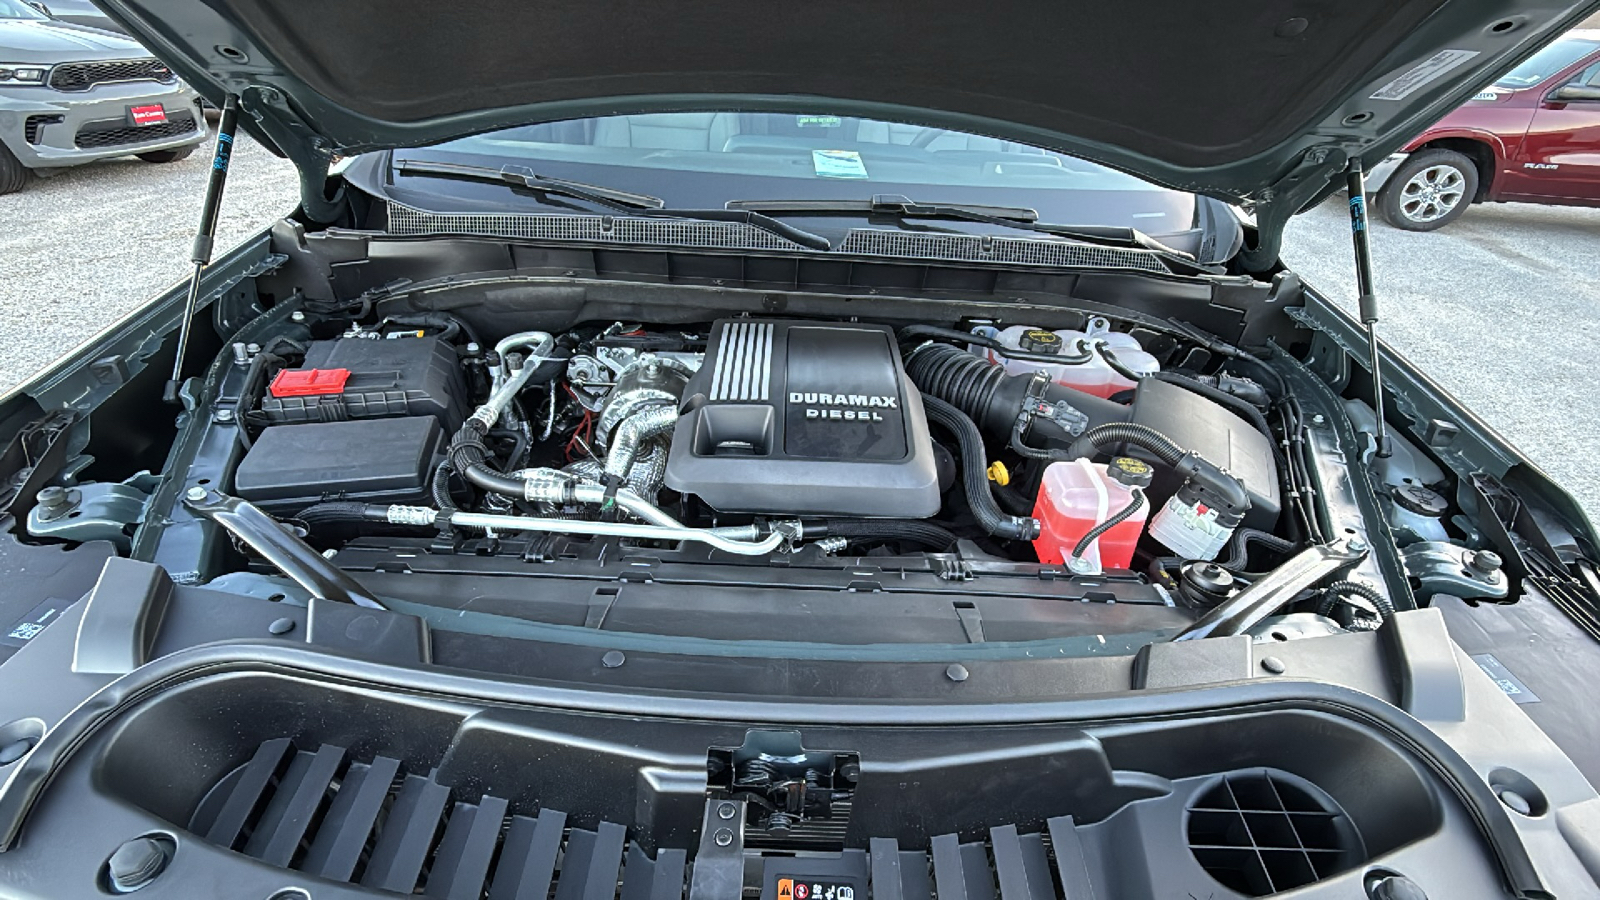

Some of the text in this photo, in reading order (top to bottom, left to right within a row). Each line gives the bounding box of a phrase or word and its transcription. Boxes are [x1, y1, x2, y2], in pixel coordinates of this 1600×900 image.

[1523, 162, 1559, 170] RAM
[789, 392, 897, 408] DURAMAX
[806, 409, 883, 421] DIESEL
